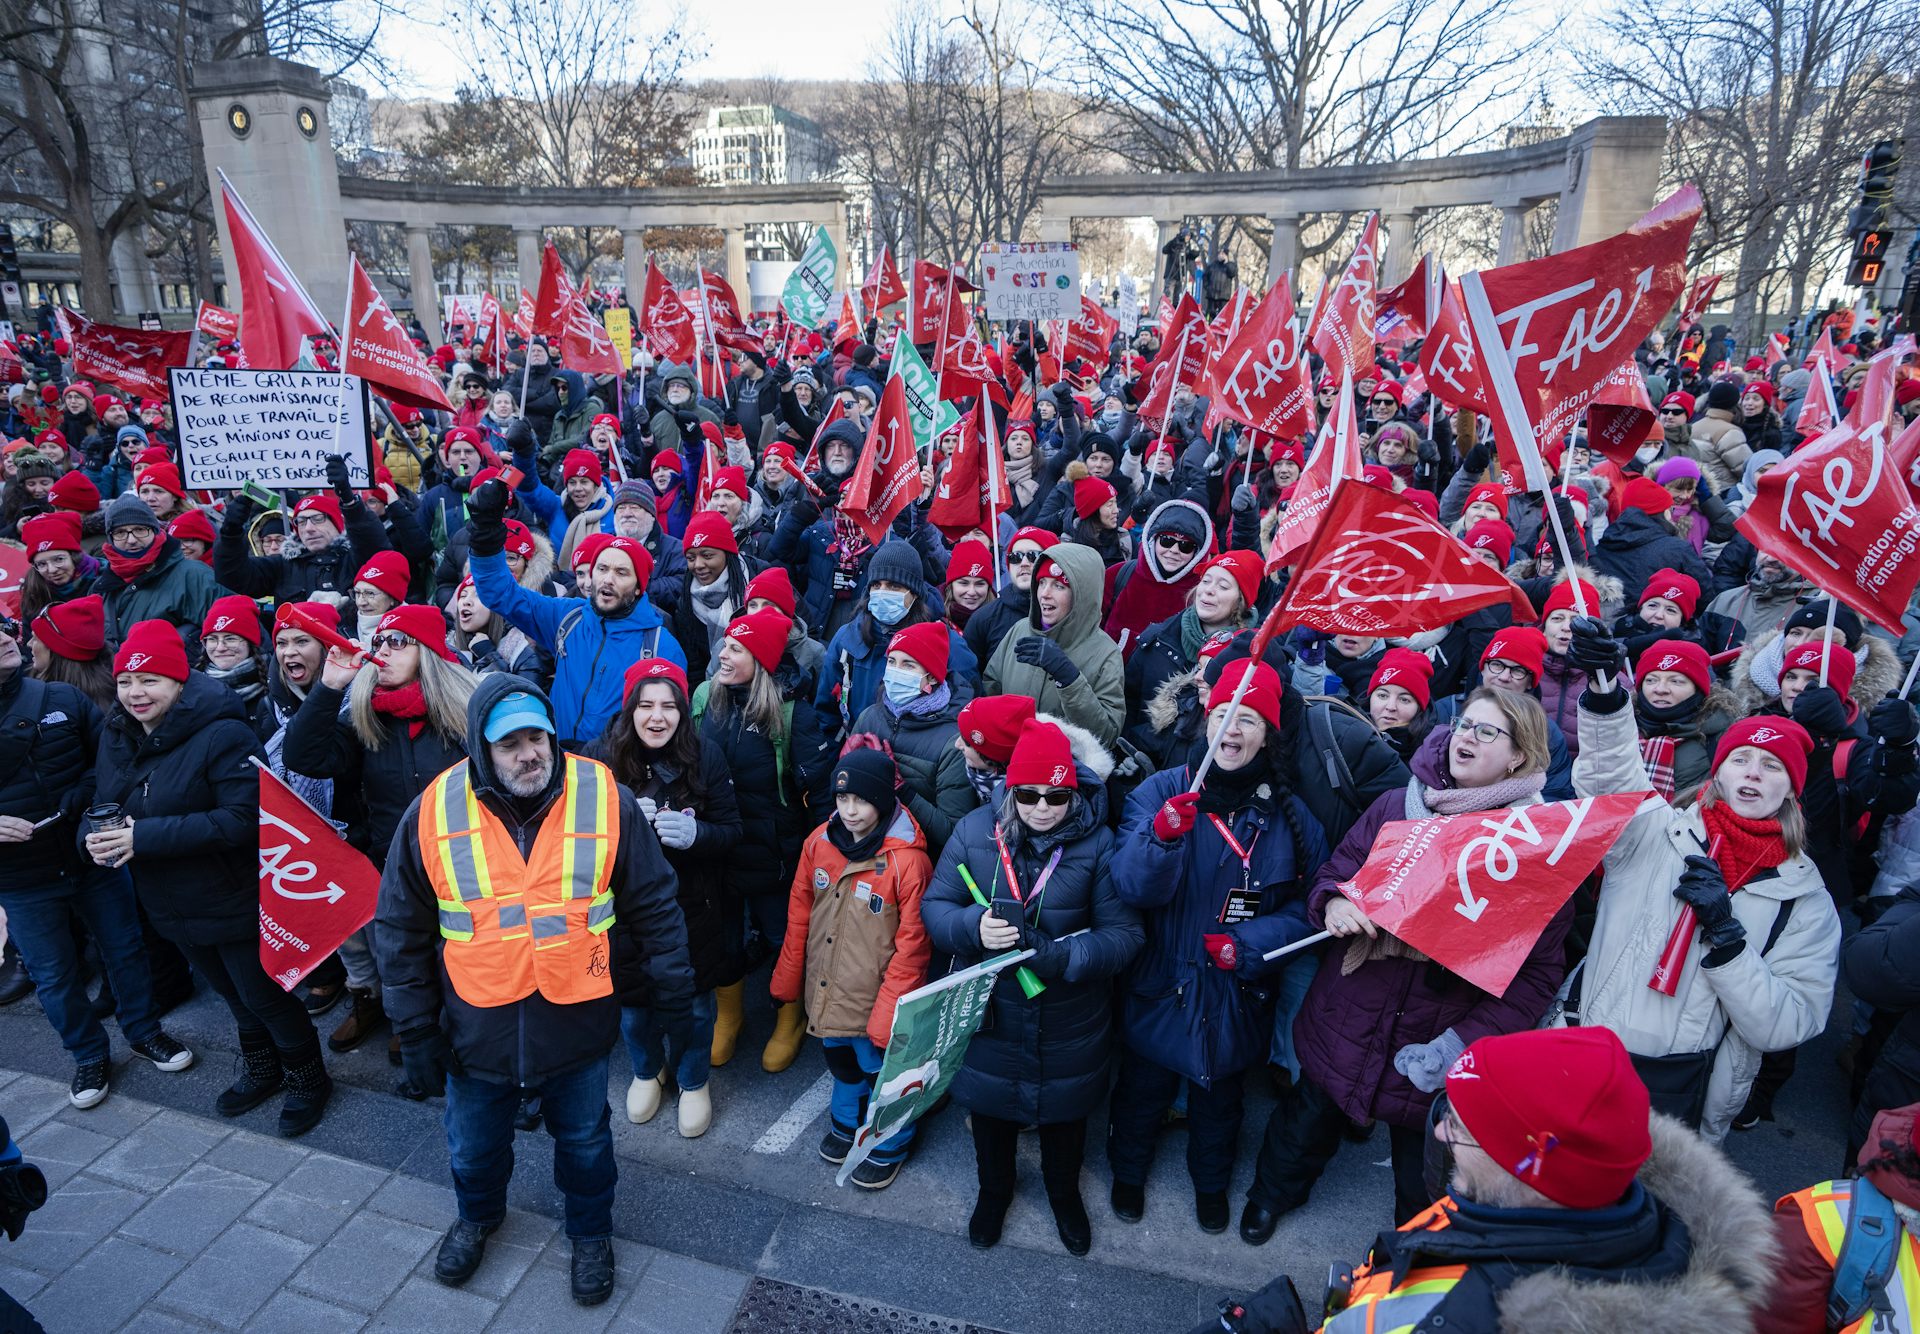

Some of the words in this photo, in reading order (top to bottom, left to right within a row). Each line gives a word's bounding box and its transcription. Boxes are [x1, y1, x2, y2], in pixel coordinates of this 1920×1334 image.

[1863, 263, 1879, 282] 0
[997, 293, 1060, 309] CHANGER
[351, 349, 366, 359] de
[353, 338, 414, 364] Fédération
[177, 369, 247, 388] MÊME
[255, 372, 297, 388] GRU
[301, 378, 312, 388] A
[317, 376, 354, 390] PLUS
[181, 394, 206, 408] DE
[185, 414, 230, 430] POUR
[233, 413, 251, 424] LE
[257, 409, 325, 423] TRAVAIL
[1533, 388, 1588, 438] dération
[186, 434, 218, 449] SES
[226, 429, 290, 444] MINIONS
[296, 429, 333, 442] QUE
[189, 450, 269, 466] LEGAULT
[274, 450, 297, 461] EN
[301, 450, 312, 460] A
[191, 465, 232, 483] CELUI
[258, 467, 281, 480] SES
